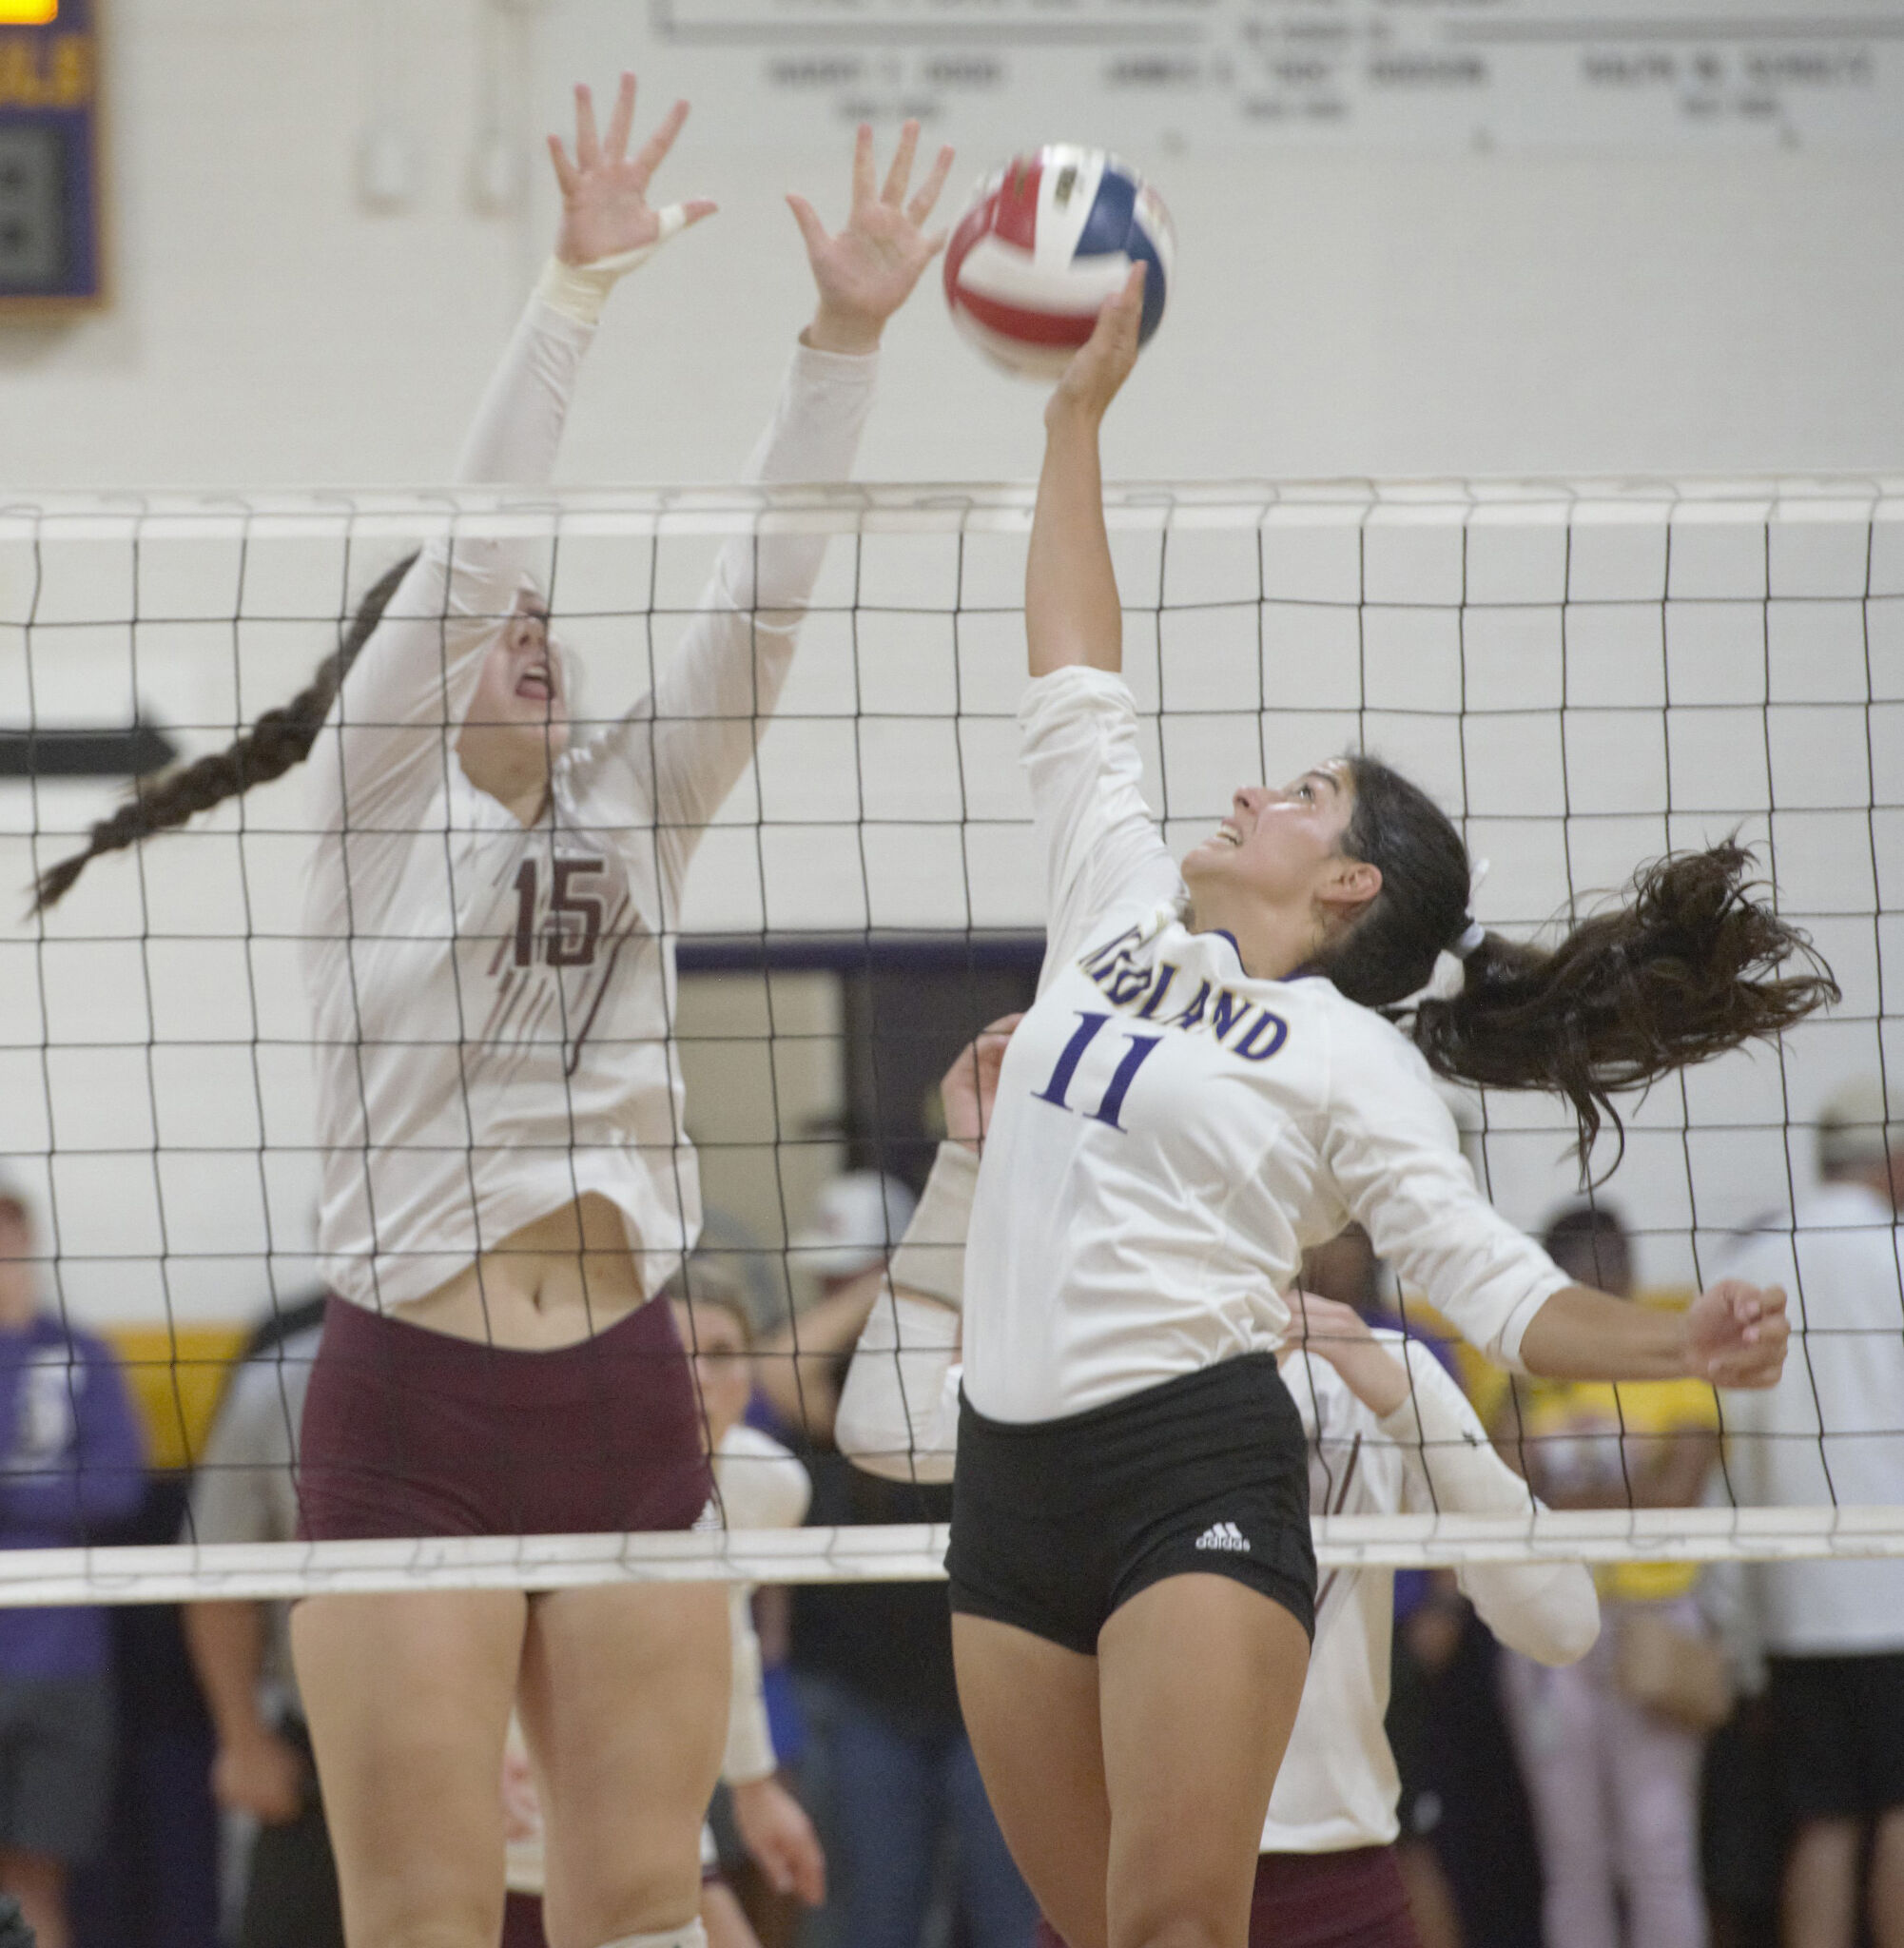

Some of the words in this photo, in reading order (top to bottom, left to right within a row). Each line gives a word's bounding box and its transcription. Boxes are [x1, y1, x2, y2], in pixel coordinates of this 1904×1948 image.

[513, 858, 605, 967] 15
[1030, 1010, 1165, 1134] 11
[1195, 1534, 1252, 1553] adidas
